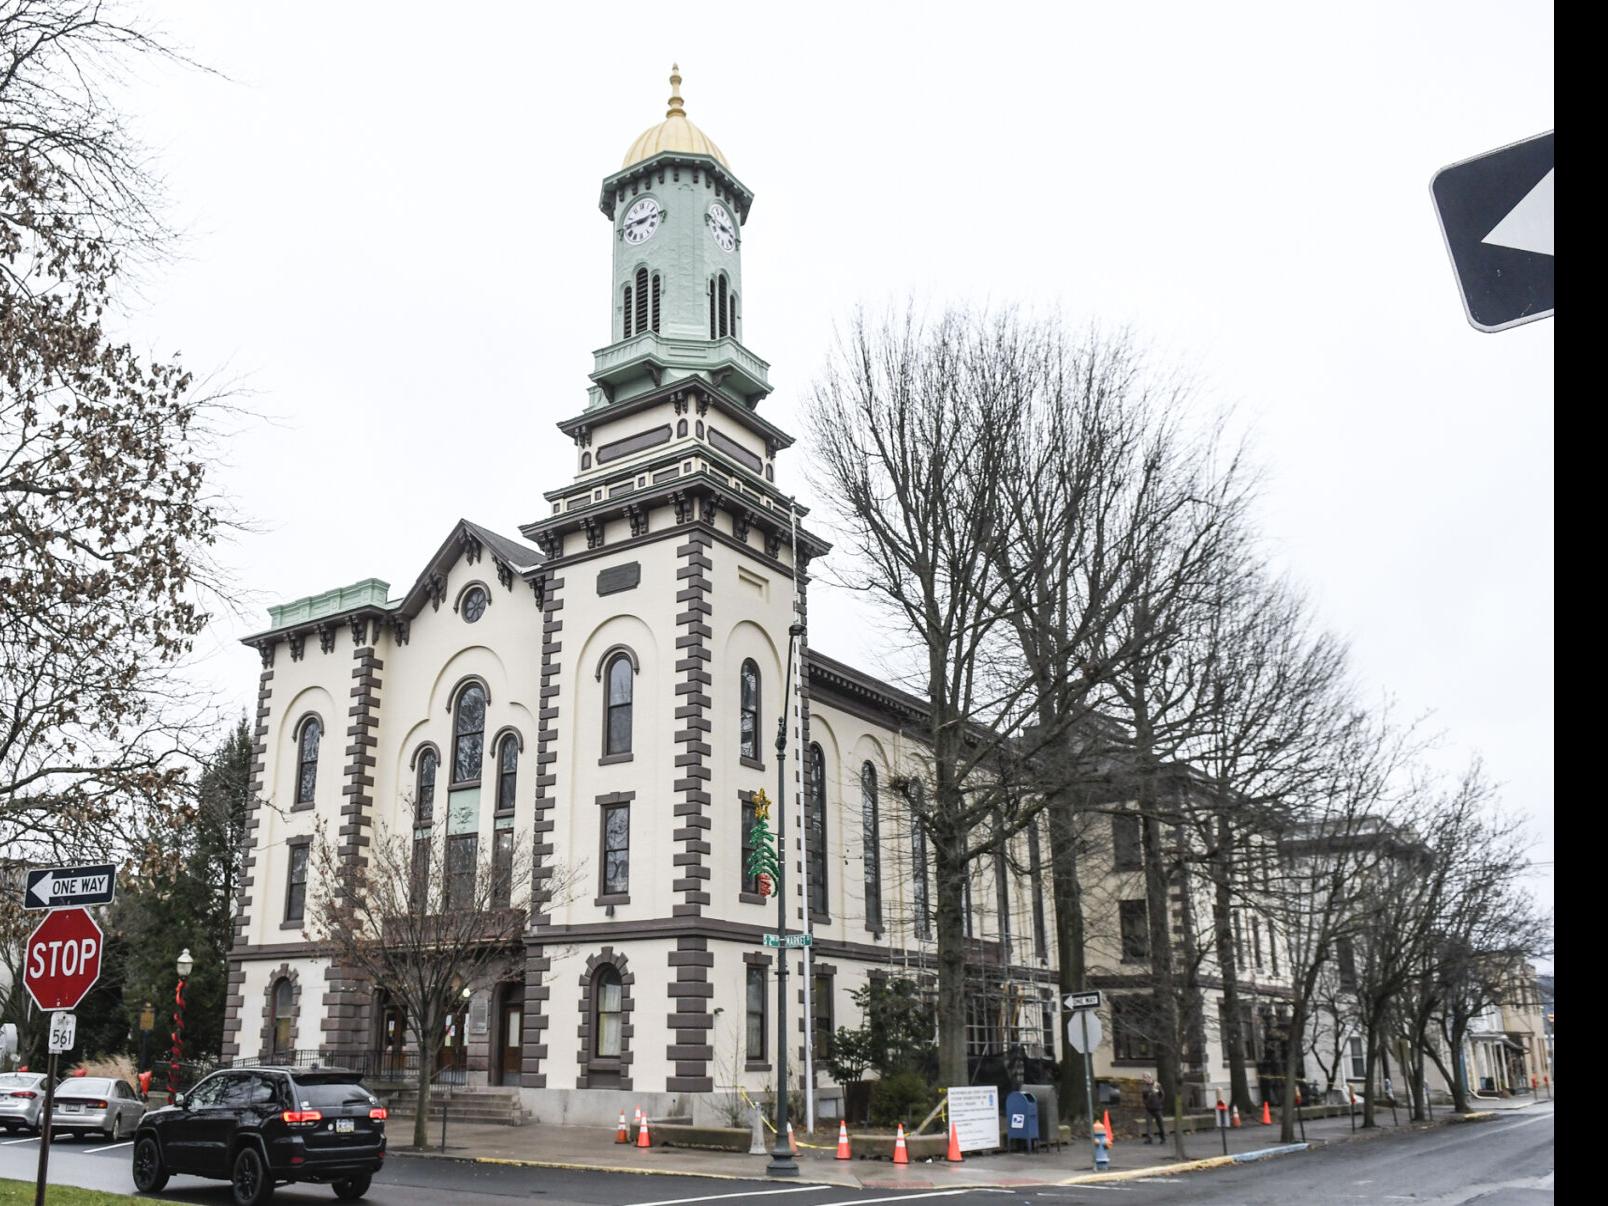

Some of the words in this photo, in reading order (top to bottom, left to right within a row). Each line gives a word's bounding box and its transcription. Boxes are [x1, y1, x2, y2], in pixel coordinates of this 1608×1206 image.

[52, 879, 77, 895] ONE
[81, 876, 106, 893] WAY
[29, 938, 97, 979] STOP
[52, 1029, 72, 1046] 561
